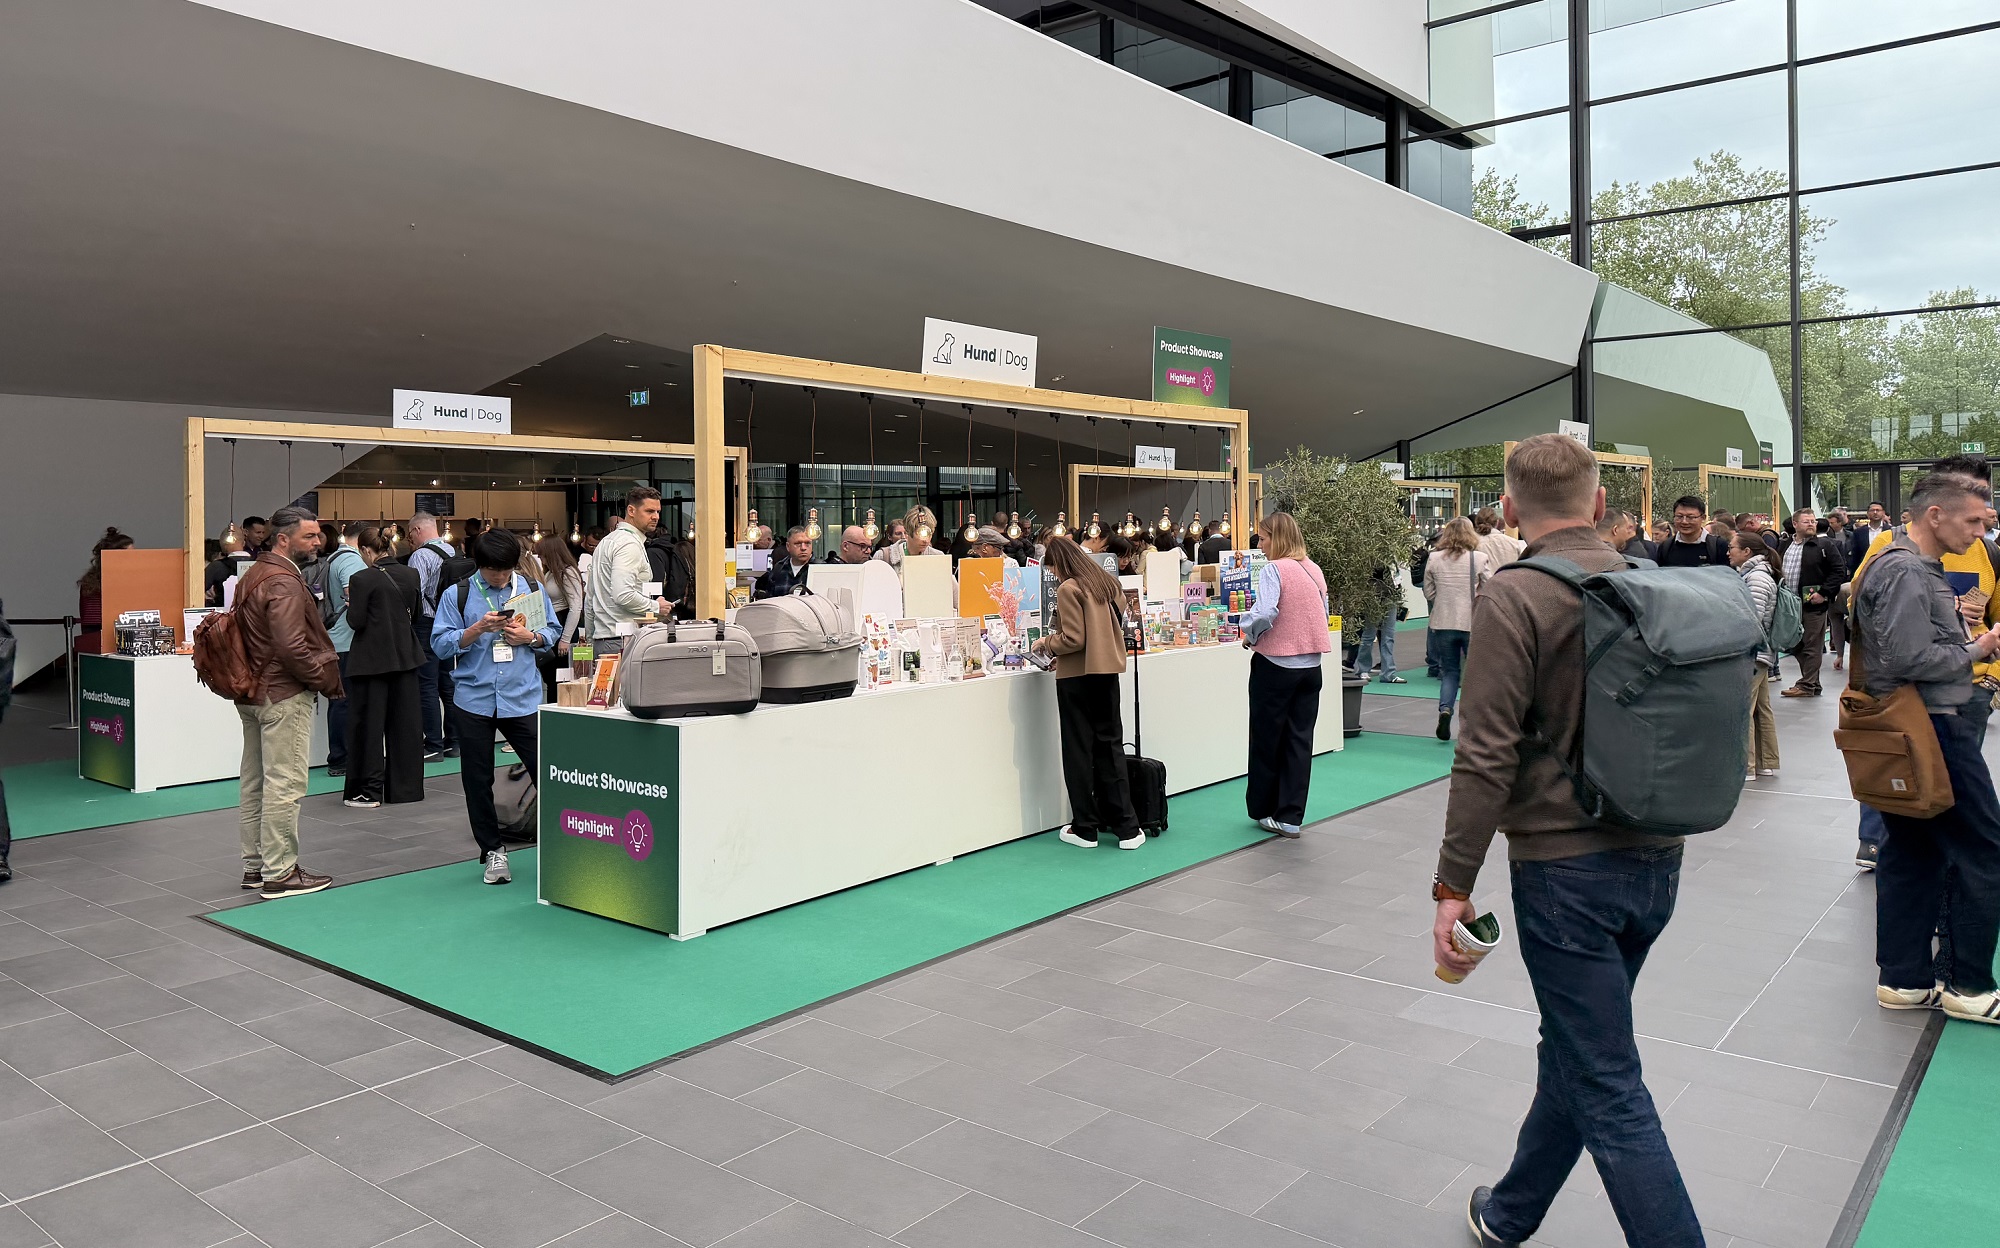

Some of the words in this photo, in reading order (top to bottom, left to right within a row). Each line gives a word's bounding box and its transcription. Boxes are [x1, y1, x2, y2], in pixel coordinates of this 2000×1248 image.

[963, 343, 997, 362] Hund
[1005, 350, 1028, 371] Dog
[1160, 340, 1188, 354] Product
[1189, 345, 1224, 360] Showcase
[1169, 372, 1196, 385] Highlight
[433, 405, 468, 418] Hund
[477, 408, 502, 423] Dog
[1148, 454, 1161, 462] Hund
[82, 688, 103, 702] Product
[103, 692, 130, 707] Showcase
[89, 721, 110, 734] Highlight
[549, 764, 599, 788] Product
[600, 772, 668, 799] Showcase
[567, 815, 614, 838] Highlight
